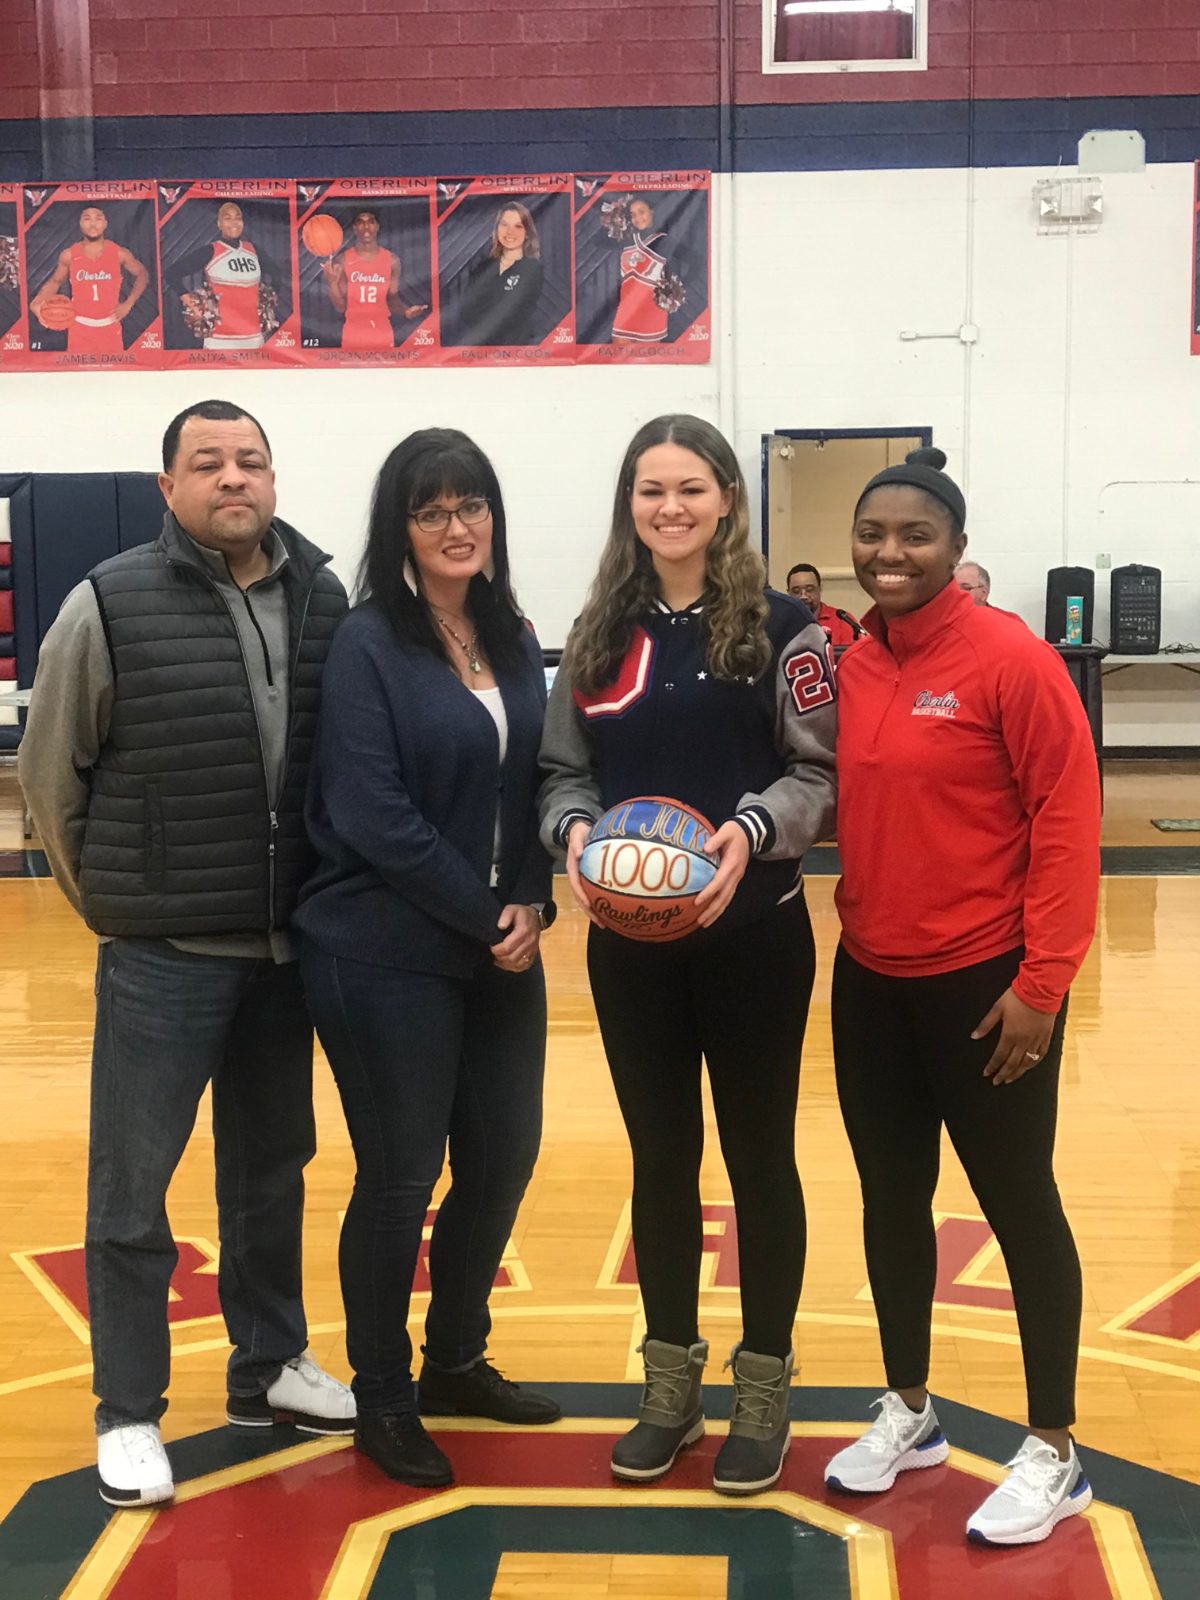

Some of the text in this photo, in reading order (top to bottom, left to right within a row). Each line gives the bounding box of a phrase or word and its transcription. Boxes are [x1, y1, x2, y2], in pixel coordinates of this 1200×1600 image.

[480, 176, 568, 186] OBERLIN
[618, 173, 706, 183] OBERLIN
[66, 182, 152, 193] OBERLIN
[200, 181, 287, 191] OBERLIN
[340, 179, 428, 189] OBERLIN
[228, 257, 257, 272] OHS
[76, 269, 112, 281] Oberlin
[351, 271, 385, 283] Oberlin
[92, 284, 99, 301] 1
[360, 285, 377, 303] 12
[413, 337, 434, 345] 2020
[553, 335, 573, 343] 2020
[688, 333, 709, 341] 2020
[3, 342, 24, 350] 2020
[31, 342, 41, 350] #1
[141, 340, 161, 349] 2020
[275, 339, 295, 347] 2020
[303, 338, 319, 347] #12
[56, 353, 136, 364] JAMES DAVIS
[785, 643, 837, 713] 2
[913, 690, 960, 709] Oberlin
[911, 707, 956, 718] BASKETBALL
[598, 842, 690, 892] 1,000
[594, 897, 684, 928] Rawlings
